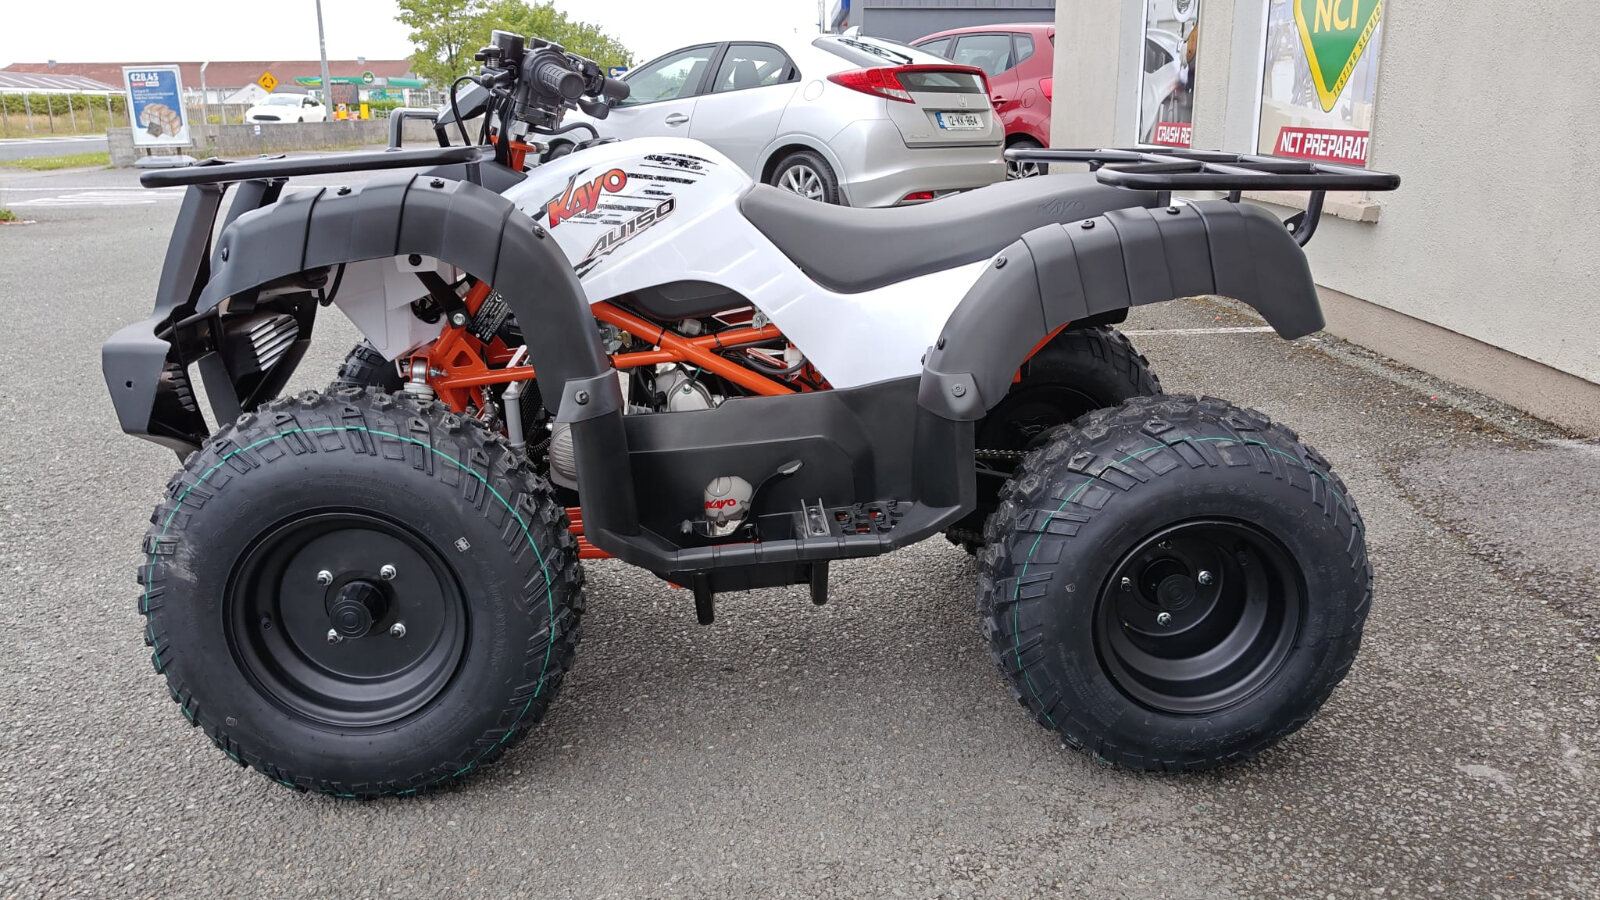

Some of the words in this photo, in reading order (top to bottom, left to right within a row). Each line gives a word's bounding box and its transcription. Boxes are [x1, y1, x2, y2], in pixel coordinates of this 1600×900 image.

[1313, 0, 1359, 33] NCT
[1333, 52, 1357, 97] TESTING
[1157, 125, 1181, 144] CRASH
[1280, 131, 1304, 154] NCT
[1303, 133, 1369, 160] PREPARAT
[547, 168, 627, 228] KAYO
[585, 197, 676, 260] AU150
[704, 498, 736, 510] KAYO
